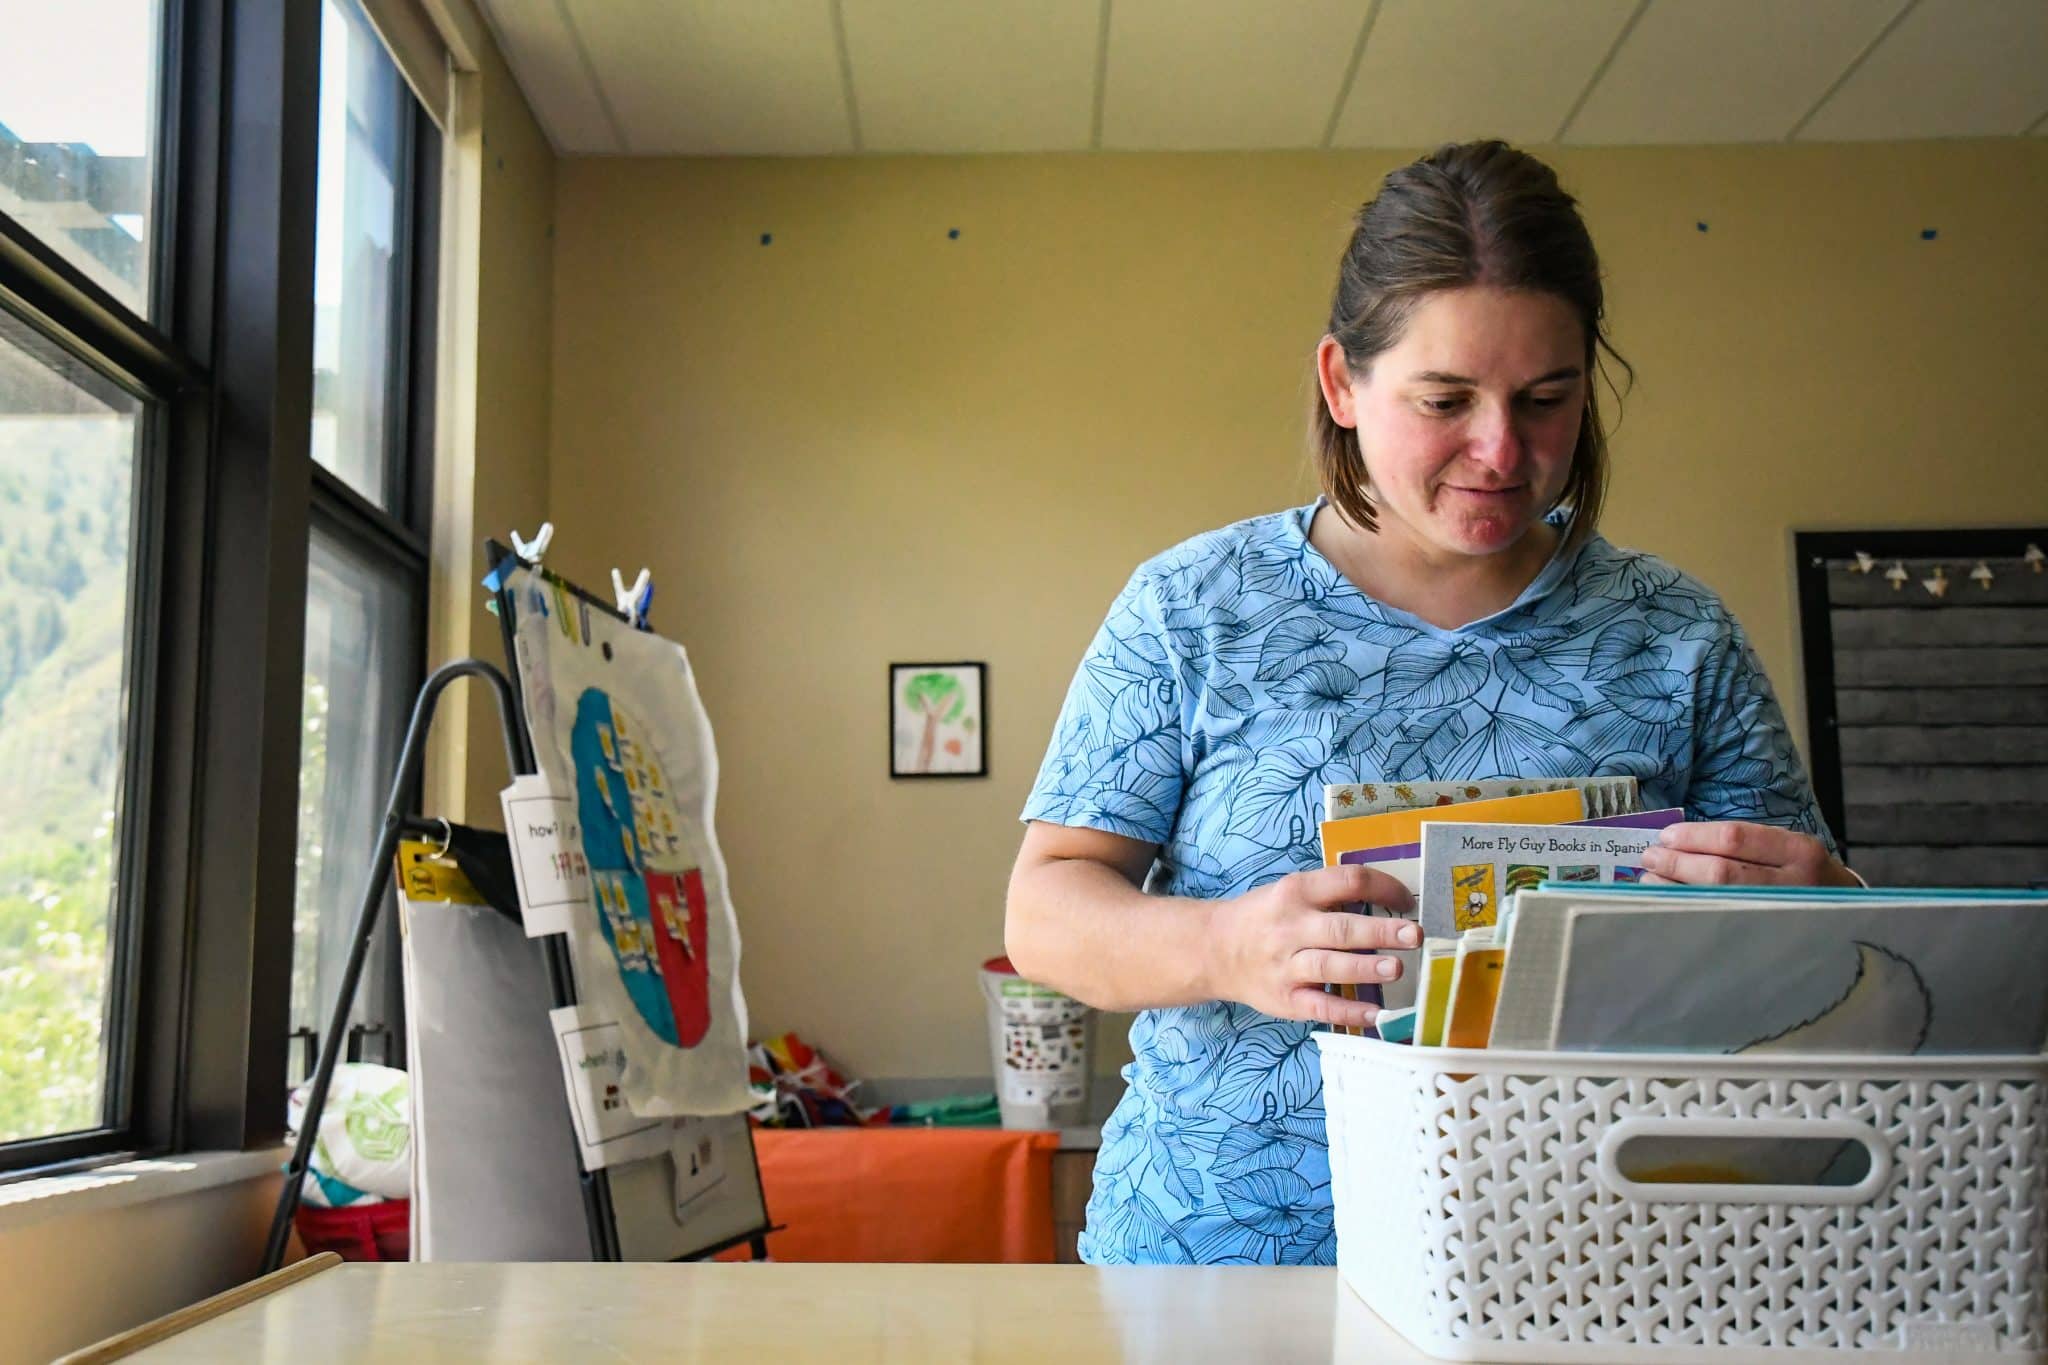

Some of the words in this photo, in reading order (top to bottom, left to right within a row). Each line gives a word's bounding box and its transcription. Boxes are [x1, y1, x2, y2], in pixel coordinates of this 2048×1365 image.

[1461, 836, 1494, 850] More
[1497, 836, 1517, 854] Fly
[1519, 837, 1546, 854] Guy
[1548, 838, 1587, 852] Books
[1590, 841, 1602, 852] in
